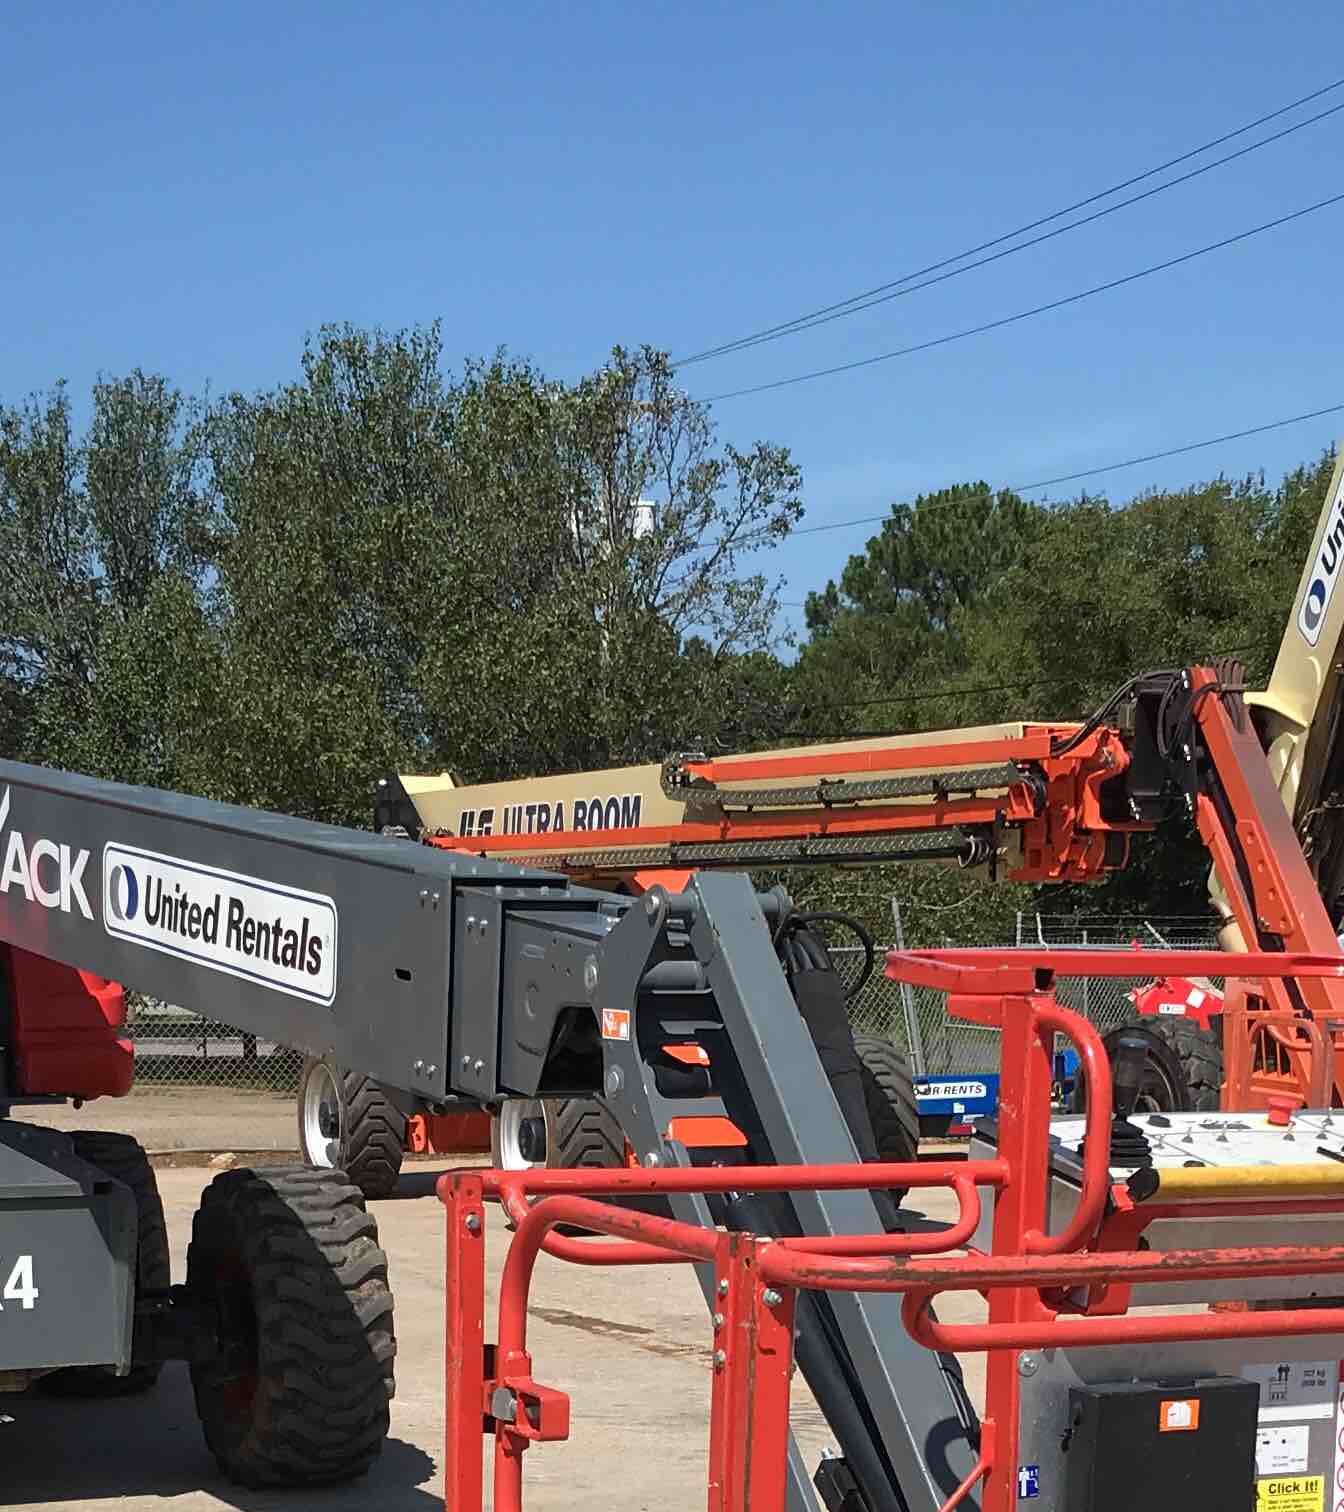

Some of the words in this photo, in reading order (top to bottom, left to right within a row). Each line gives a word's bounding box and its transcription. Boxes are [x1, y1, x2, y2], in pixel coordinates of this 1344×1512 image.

[572, 793, 643, 832] BOOM
[144, 874, 221, 945] United
[225, 896, 323, 976] Rentals
[1268, 1481, 1301, 1495] Click
[1304, 1479, 1318, 1492] It!
